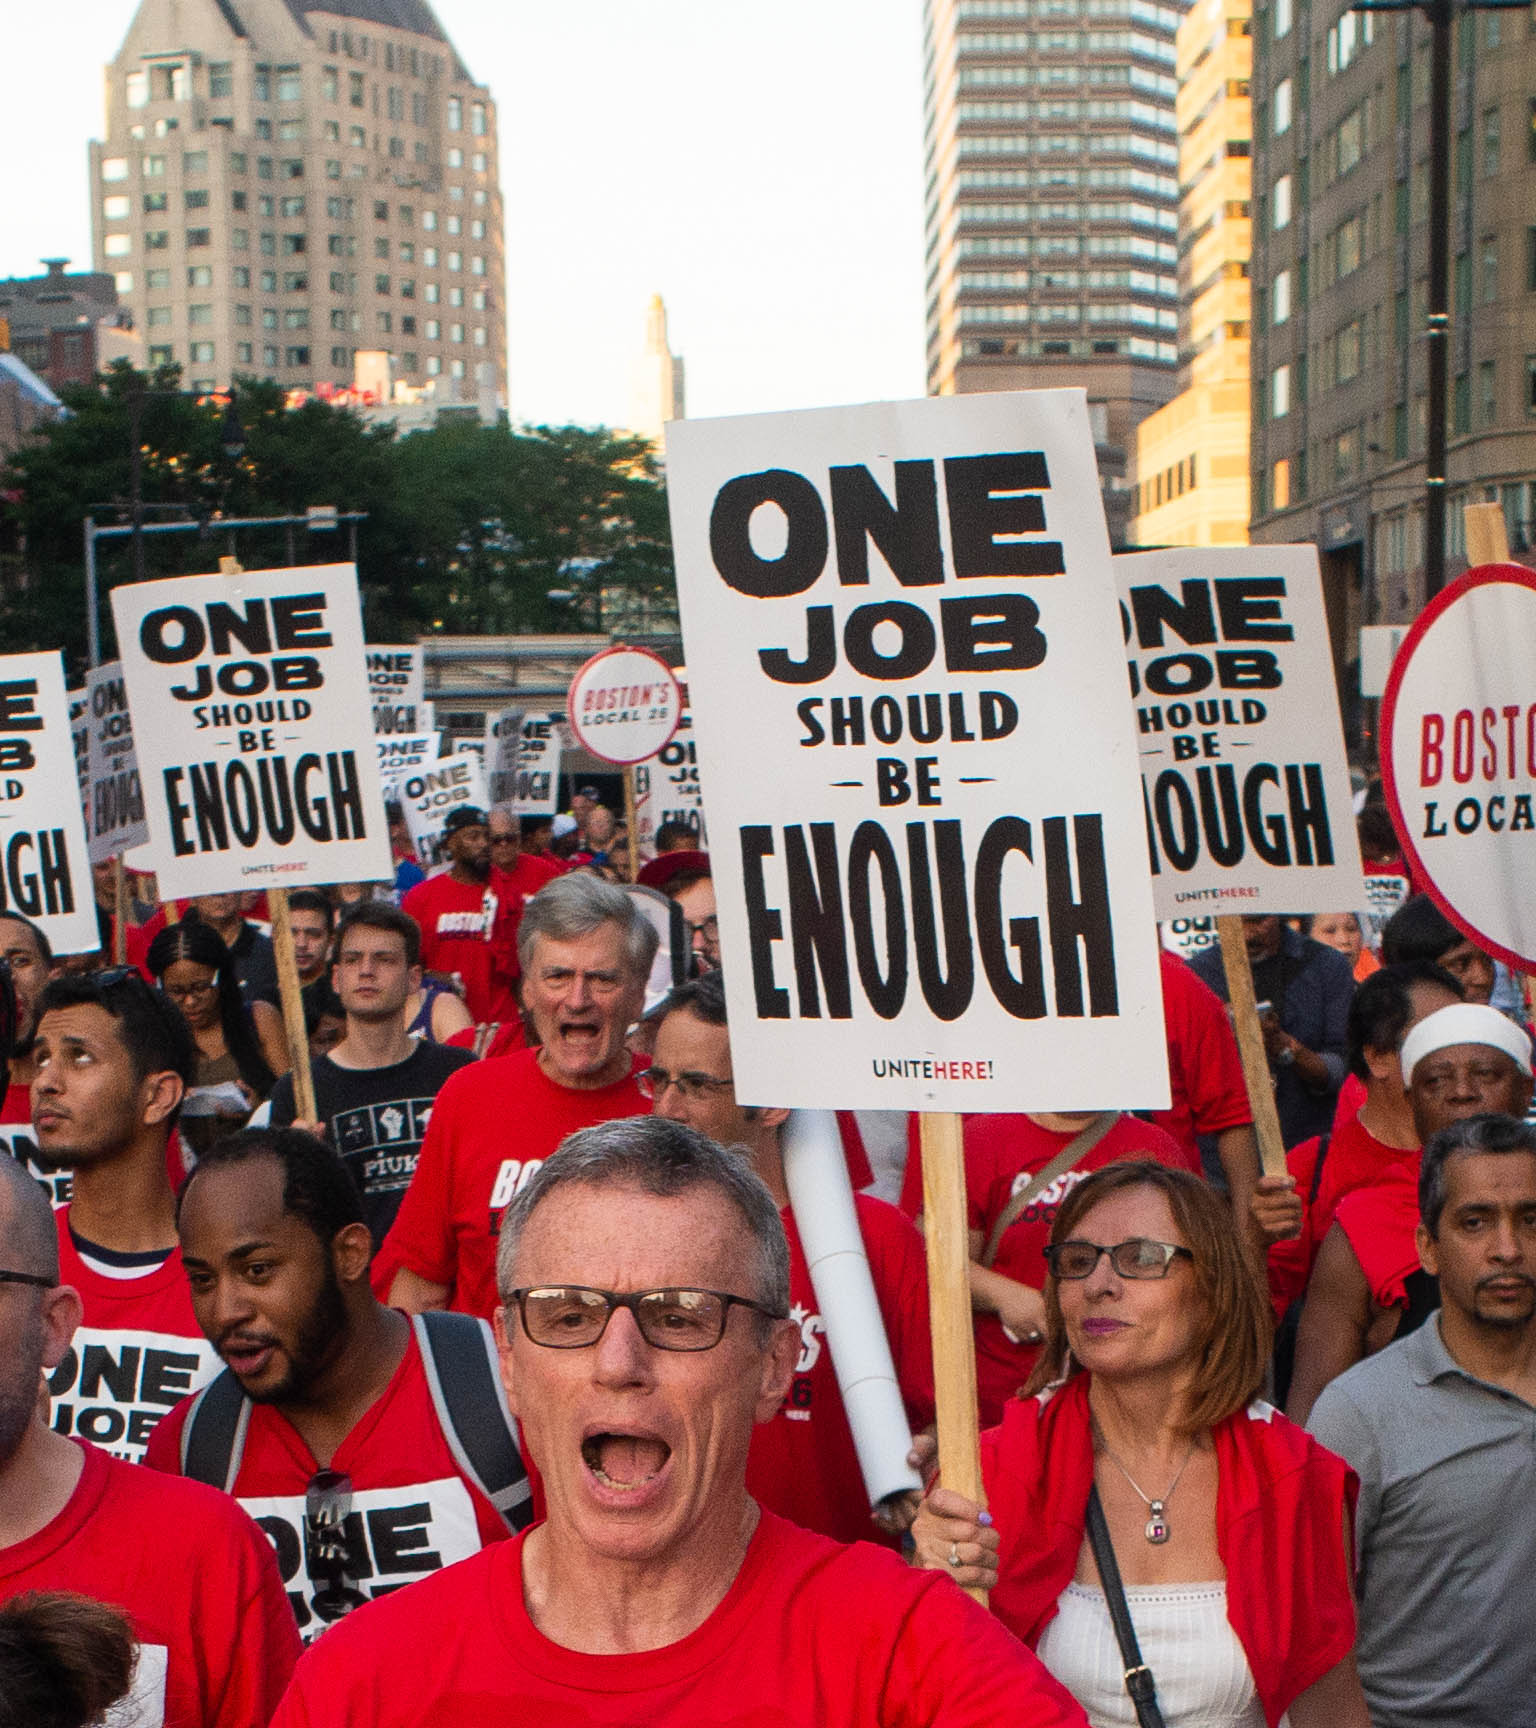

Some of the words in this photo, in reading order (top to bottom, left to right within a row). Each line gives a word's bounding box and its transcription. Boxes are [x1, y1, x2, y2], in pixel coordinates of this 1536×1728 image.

[710, 451, 1066, 598] ONE
[140, 593, 334, 664] ONE
[758, 593, 1047, 685] JOB
[1119, 577, 1295, 650] NE
[170, 656, 324, 702] JOB
[193, 699, 313, 729] SHOULD
[237, 729, 277, 753] BE
[797, 691, 1019, 747] SHOULD
[1138, 699, 1268, 734] HOULD
[1172, 732, 1222, 762] BE
[164, 750, 368, 859] ENOUGH
[877, 757, 942, 807] BE
[1141, 762, 1335, 876] OUGH
[740, 813, 1120, 1022] ENOUGH
[872, 1059, 994, 1081] UNITEHERE!
